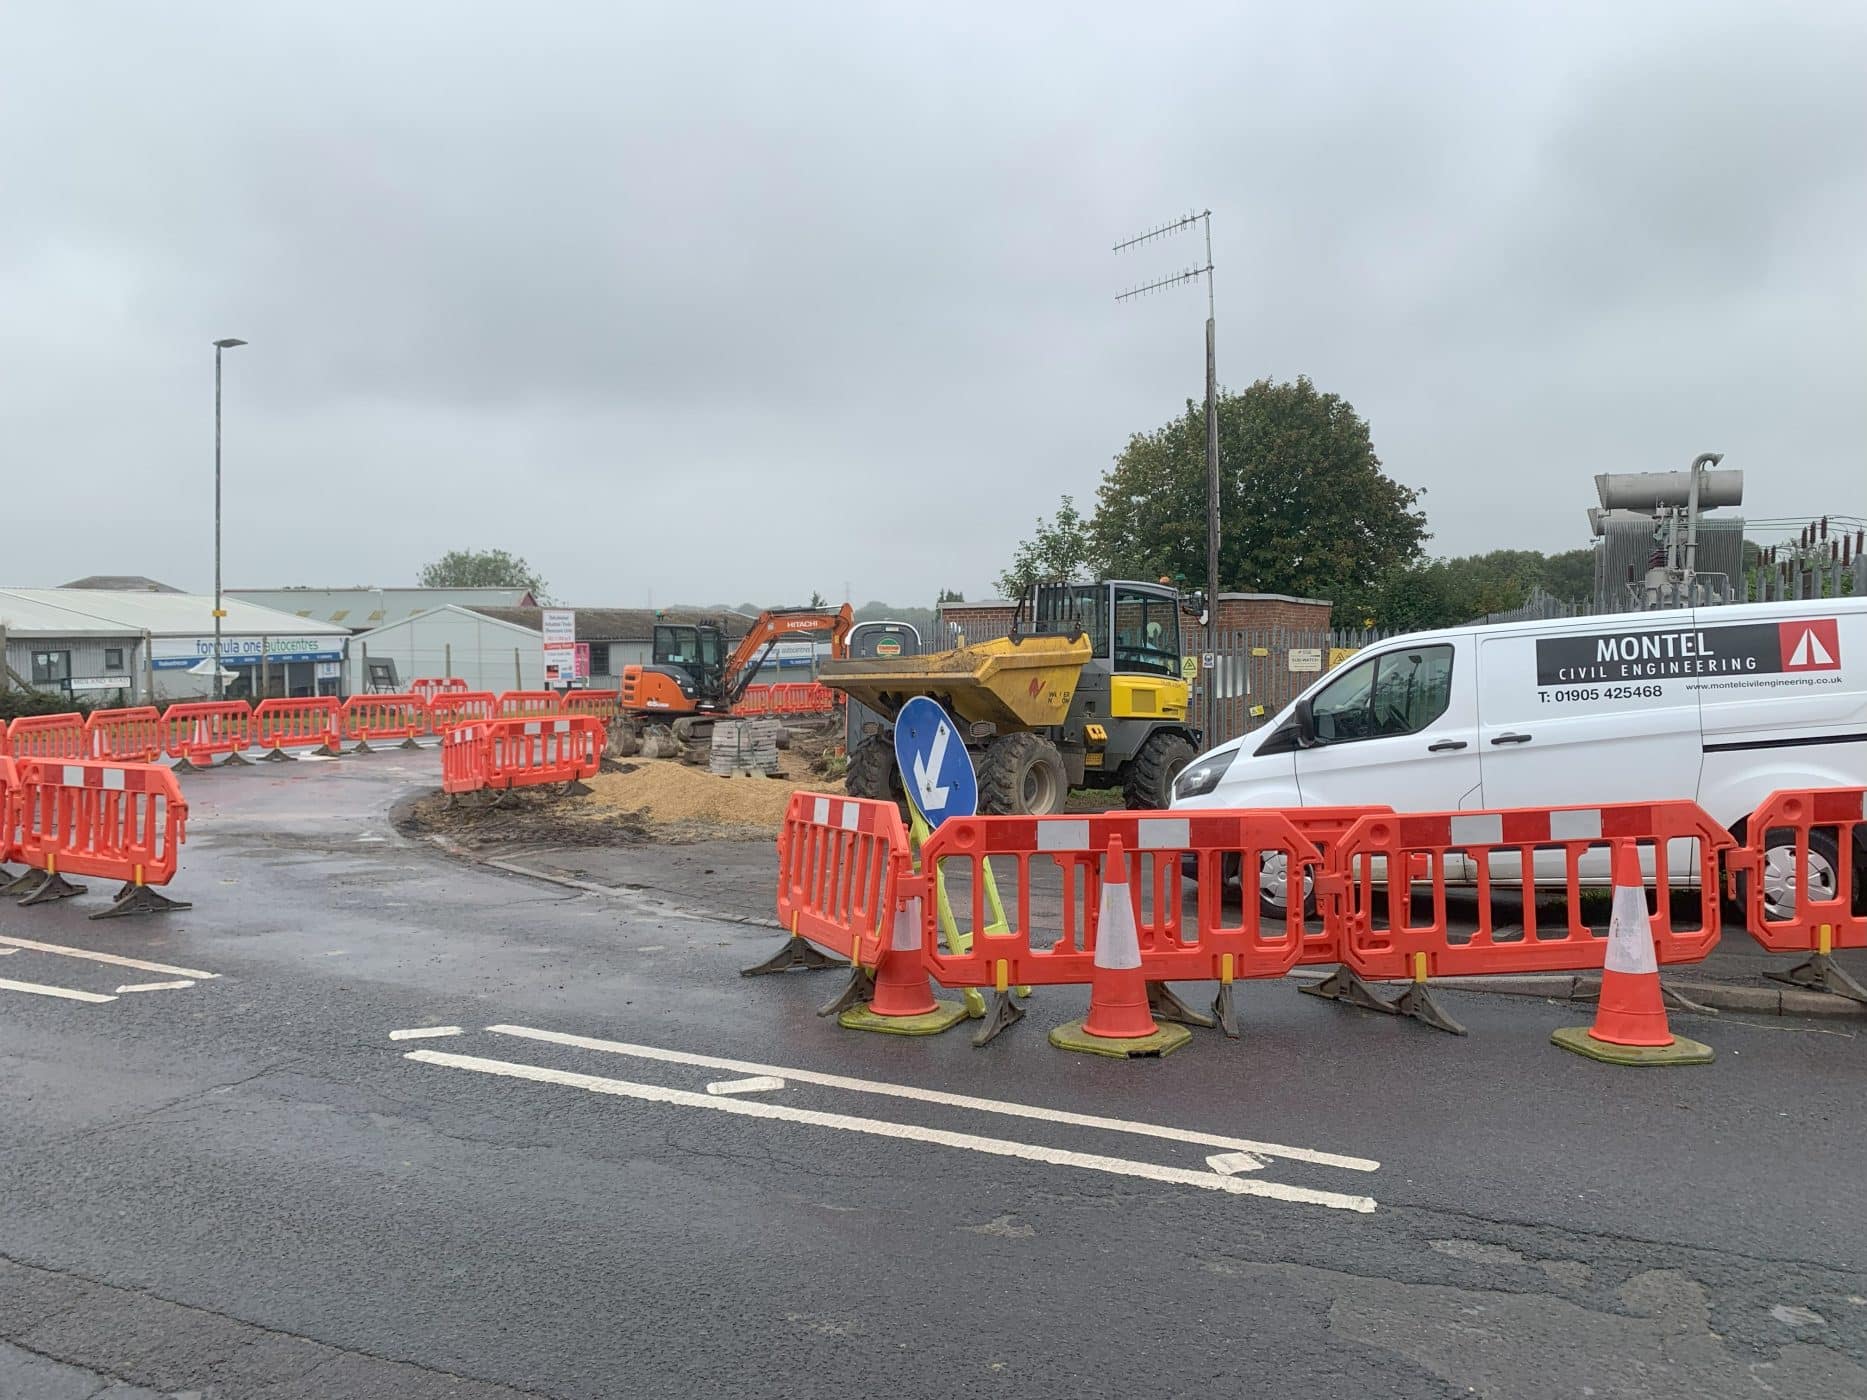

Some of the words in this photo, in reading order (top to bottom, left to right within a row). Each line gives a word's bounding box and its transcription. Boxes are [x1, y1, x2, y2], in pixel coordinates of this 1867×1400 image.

[787, 620, 818, 628] HITACHI
[243, 639, 261, 653] one
[1597, 632, 1714, 662] MONTEL
[1559, 667, 1607, 681] CIVIL
[1621, 657, 1758, 677] ENGINEERING
[1685, 676, 1843, 691] www.montelcivilengineering.co.uk
[1538, 691, 1551, 703] T:
[1555, 688, 1600, 702] 01905
[1604, 685, 1663, 700] 425468
